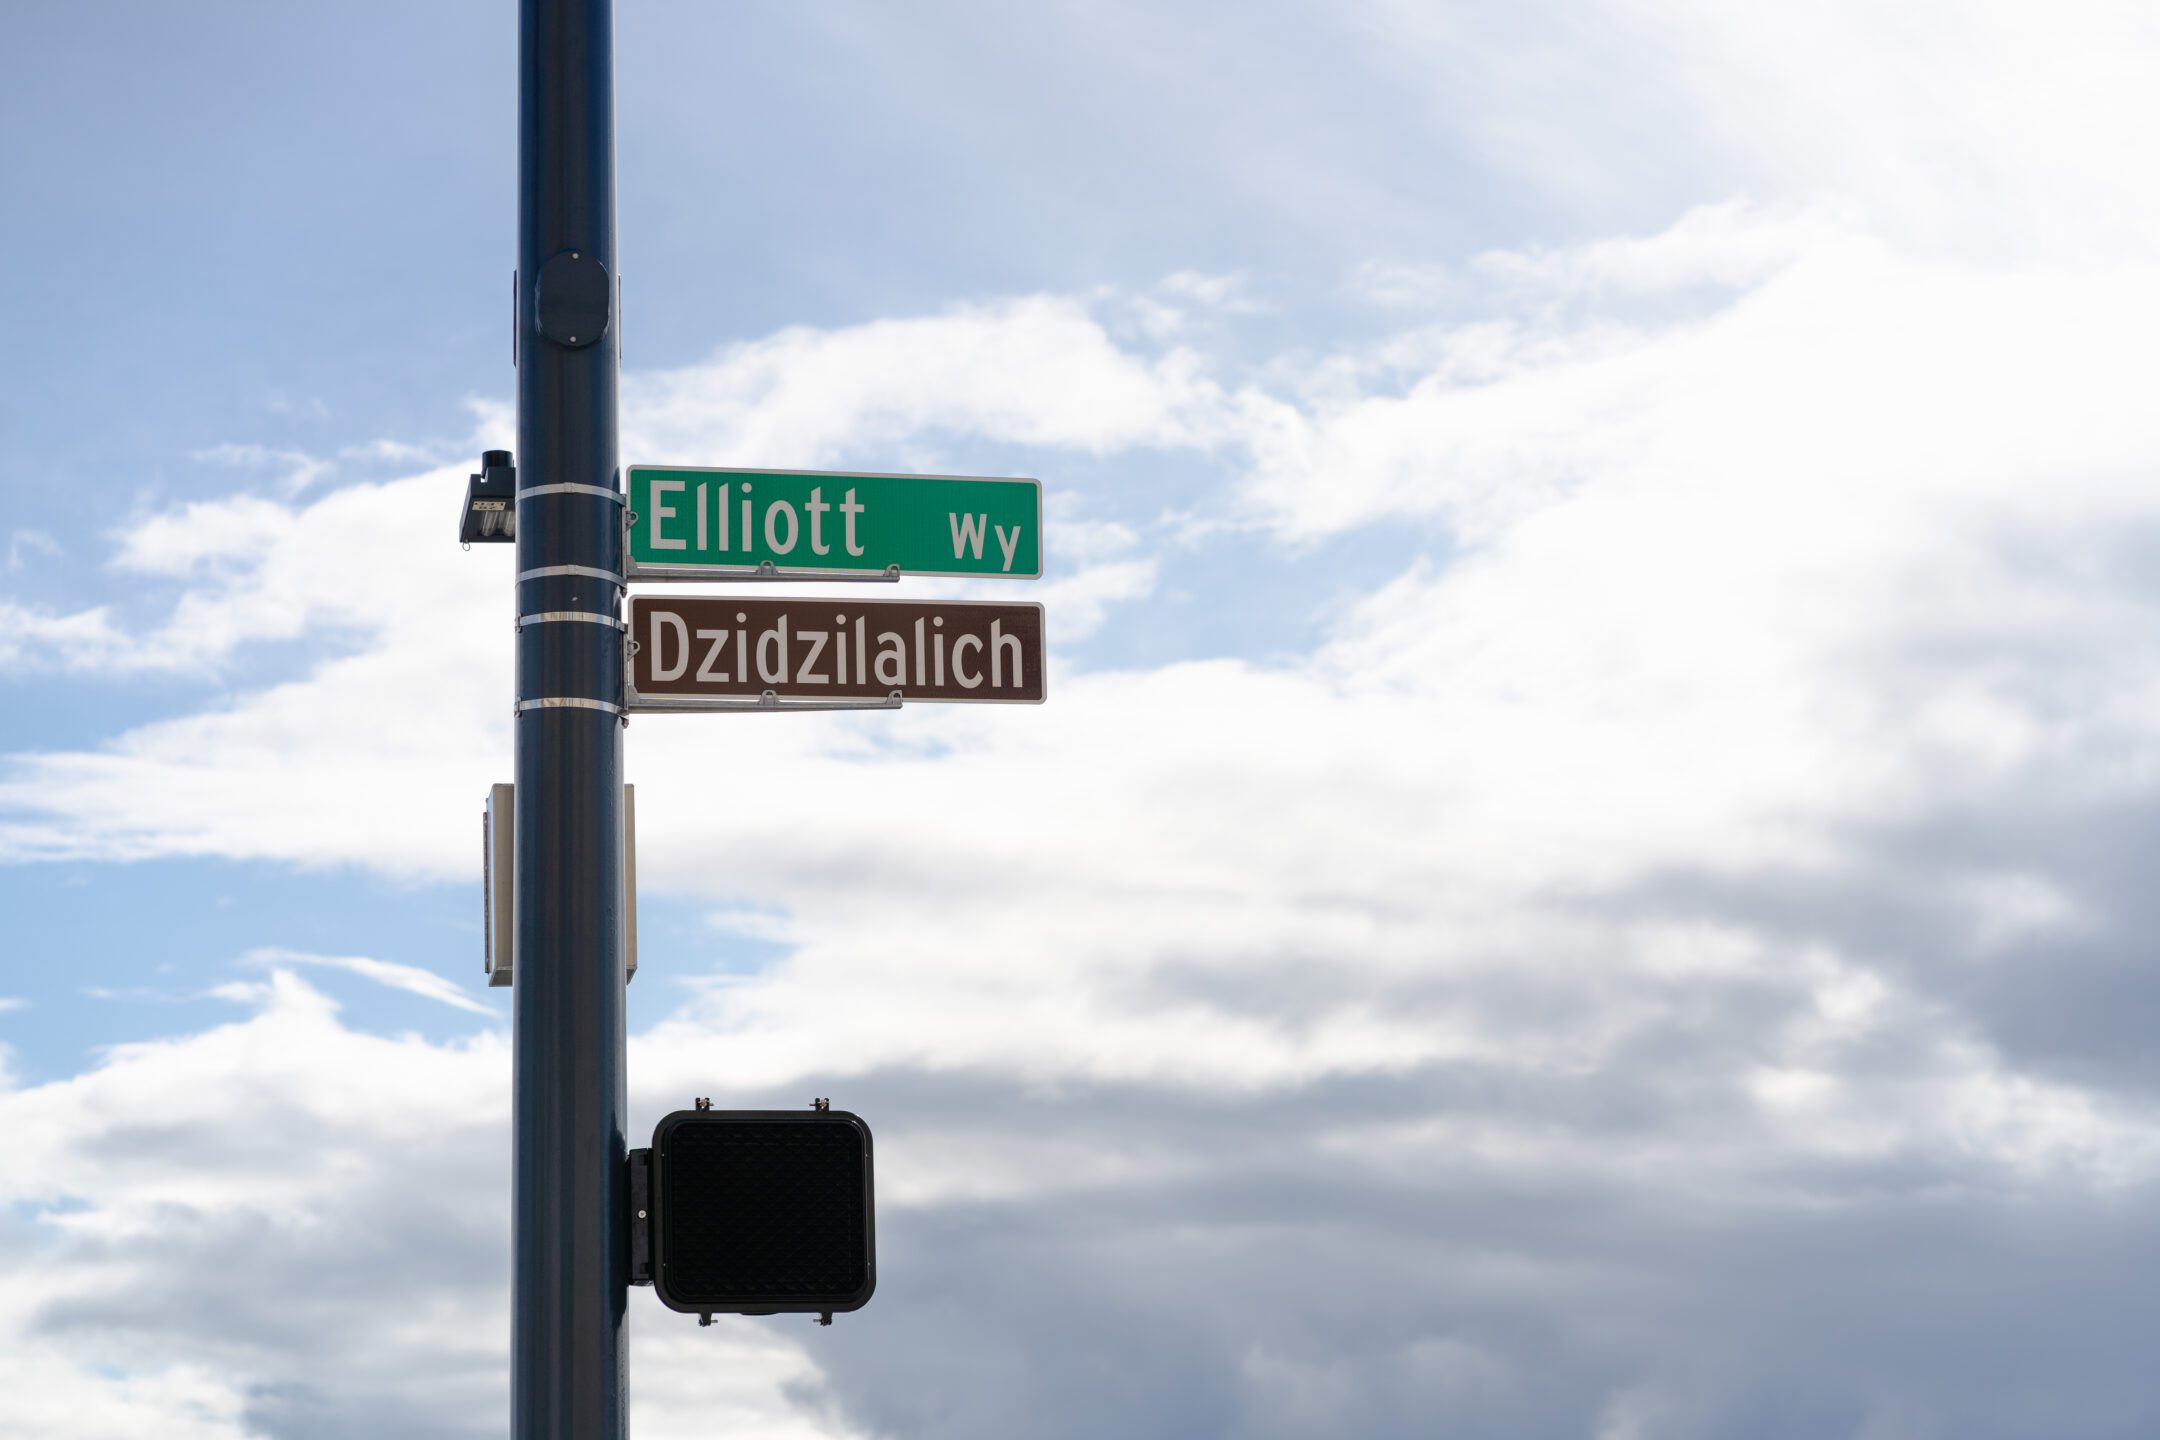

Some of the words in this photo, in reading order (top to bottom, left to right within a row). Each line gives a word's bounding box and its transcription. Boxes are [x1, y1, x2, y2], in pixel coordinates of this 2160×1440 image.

[650, 480, 865, 556] Elliott
[949, 512, 1021, 571] Wy
[650, 611, 1023, 689] Dzidzilalich
